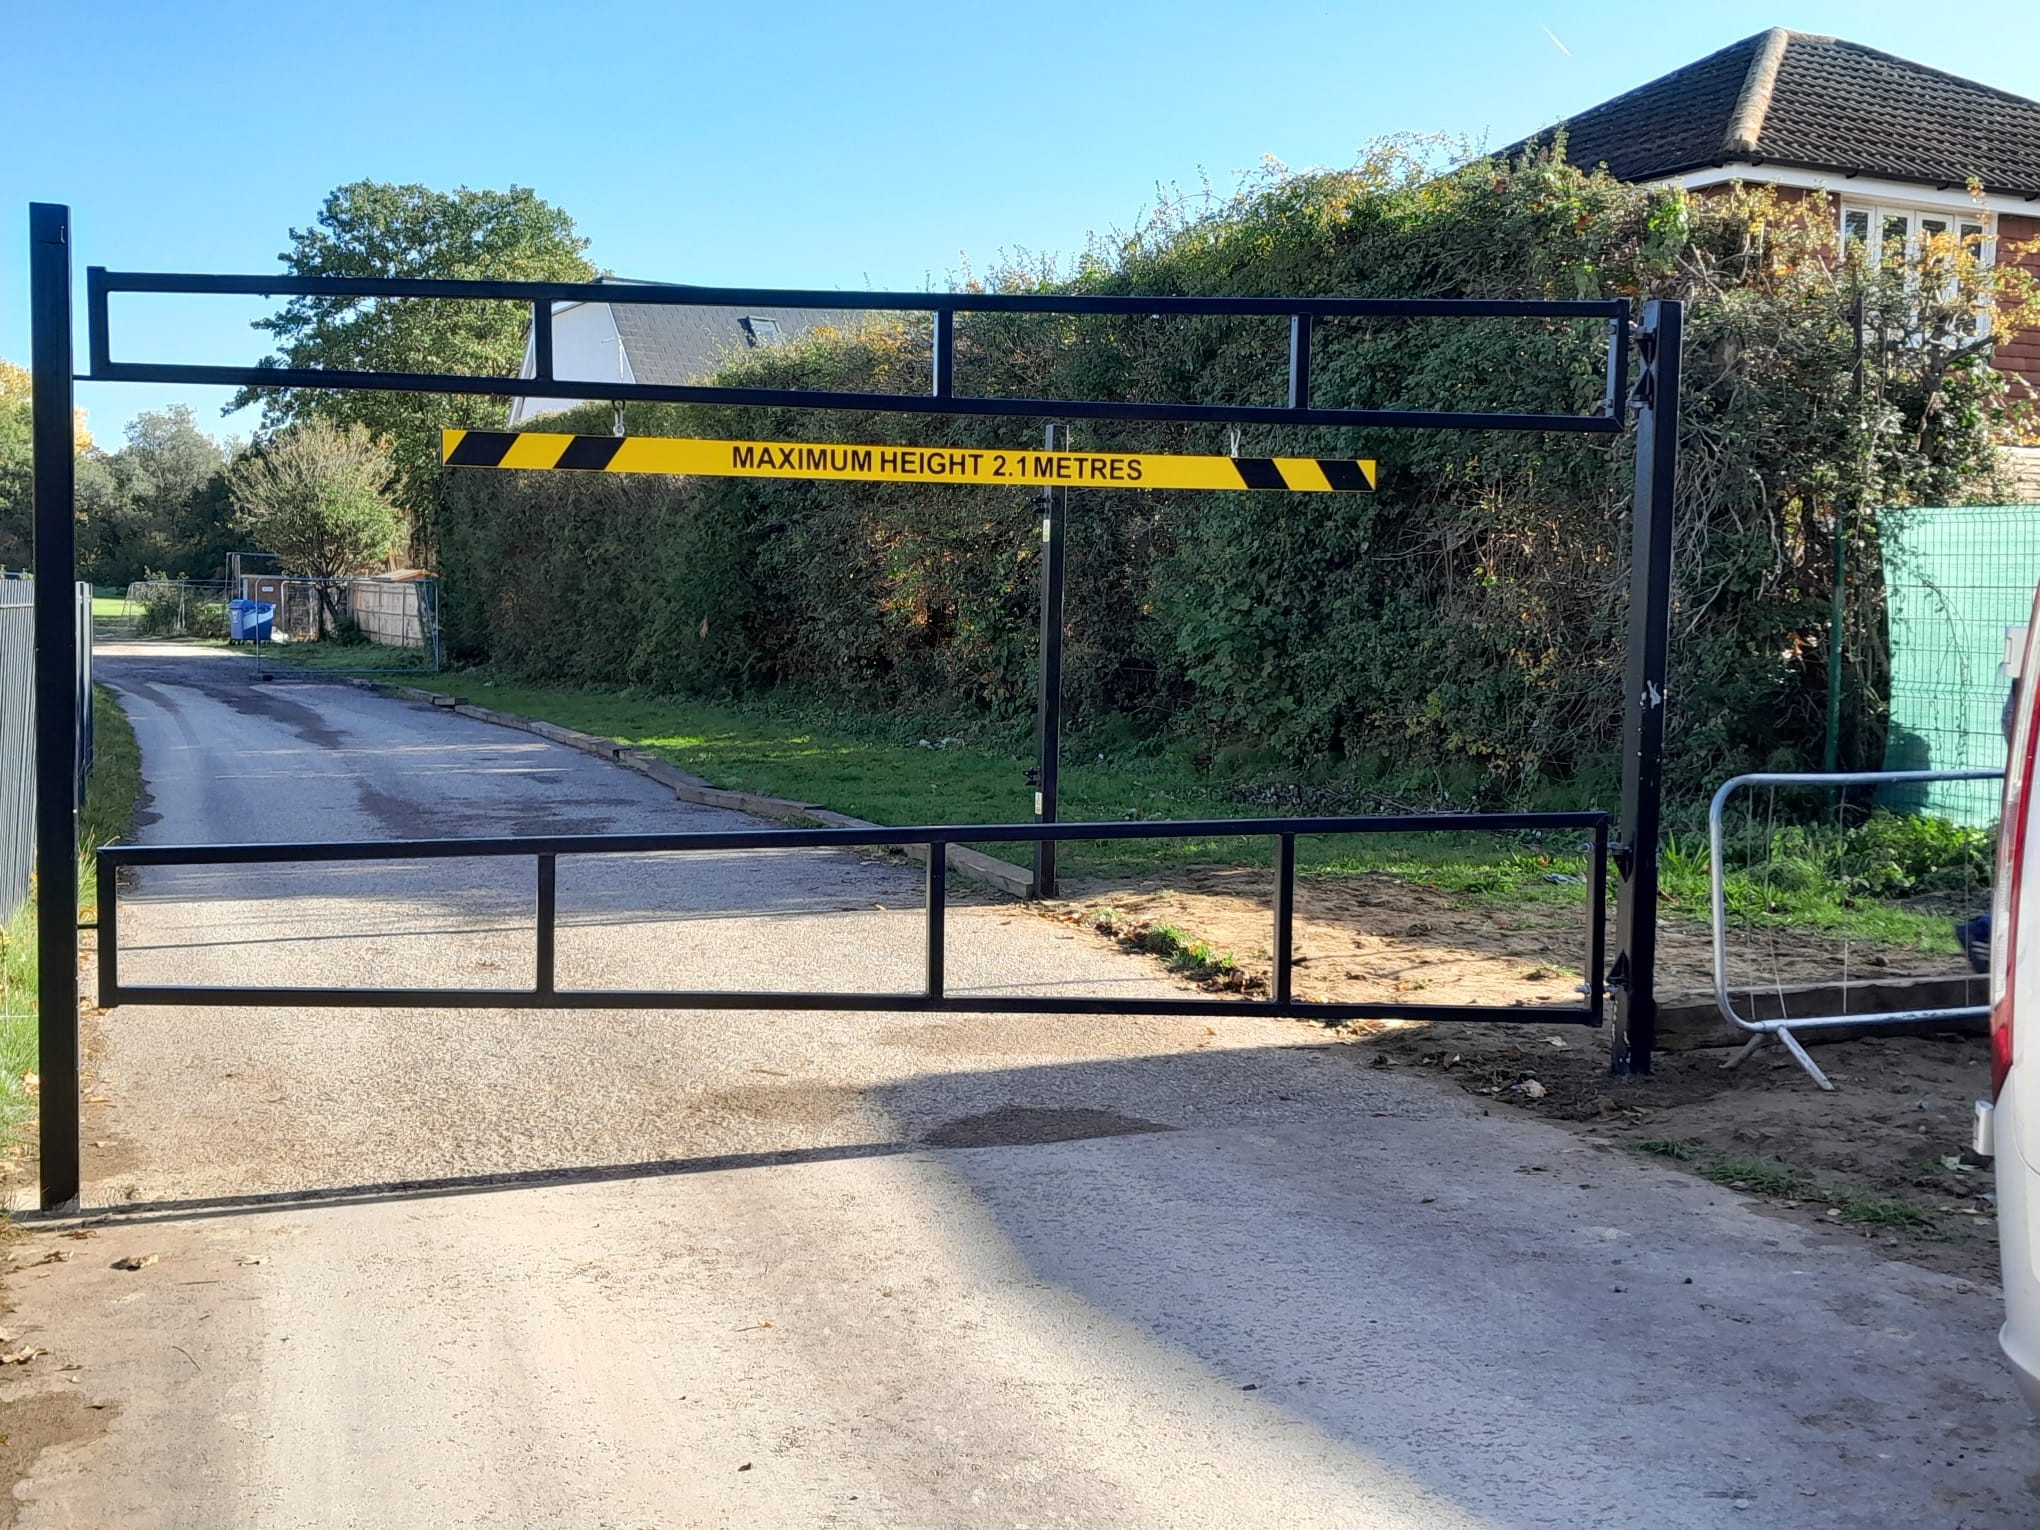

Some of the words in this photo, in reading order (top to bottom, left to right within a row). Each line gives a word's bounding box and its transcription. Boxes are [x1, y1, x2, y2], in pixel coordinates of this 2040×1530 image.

[732, 446, 872, 472] MAXIMUM
[880, 451, 984, 475] HEIGHT
[992, 454, 1026, 477] 2.1
[1033, 456, 1143, 481] METRES
